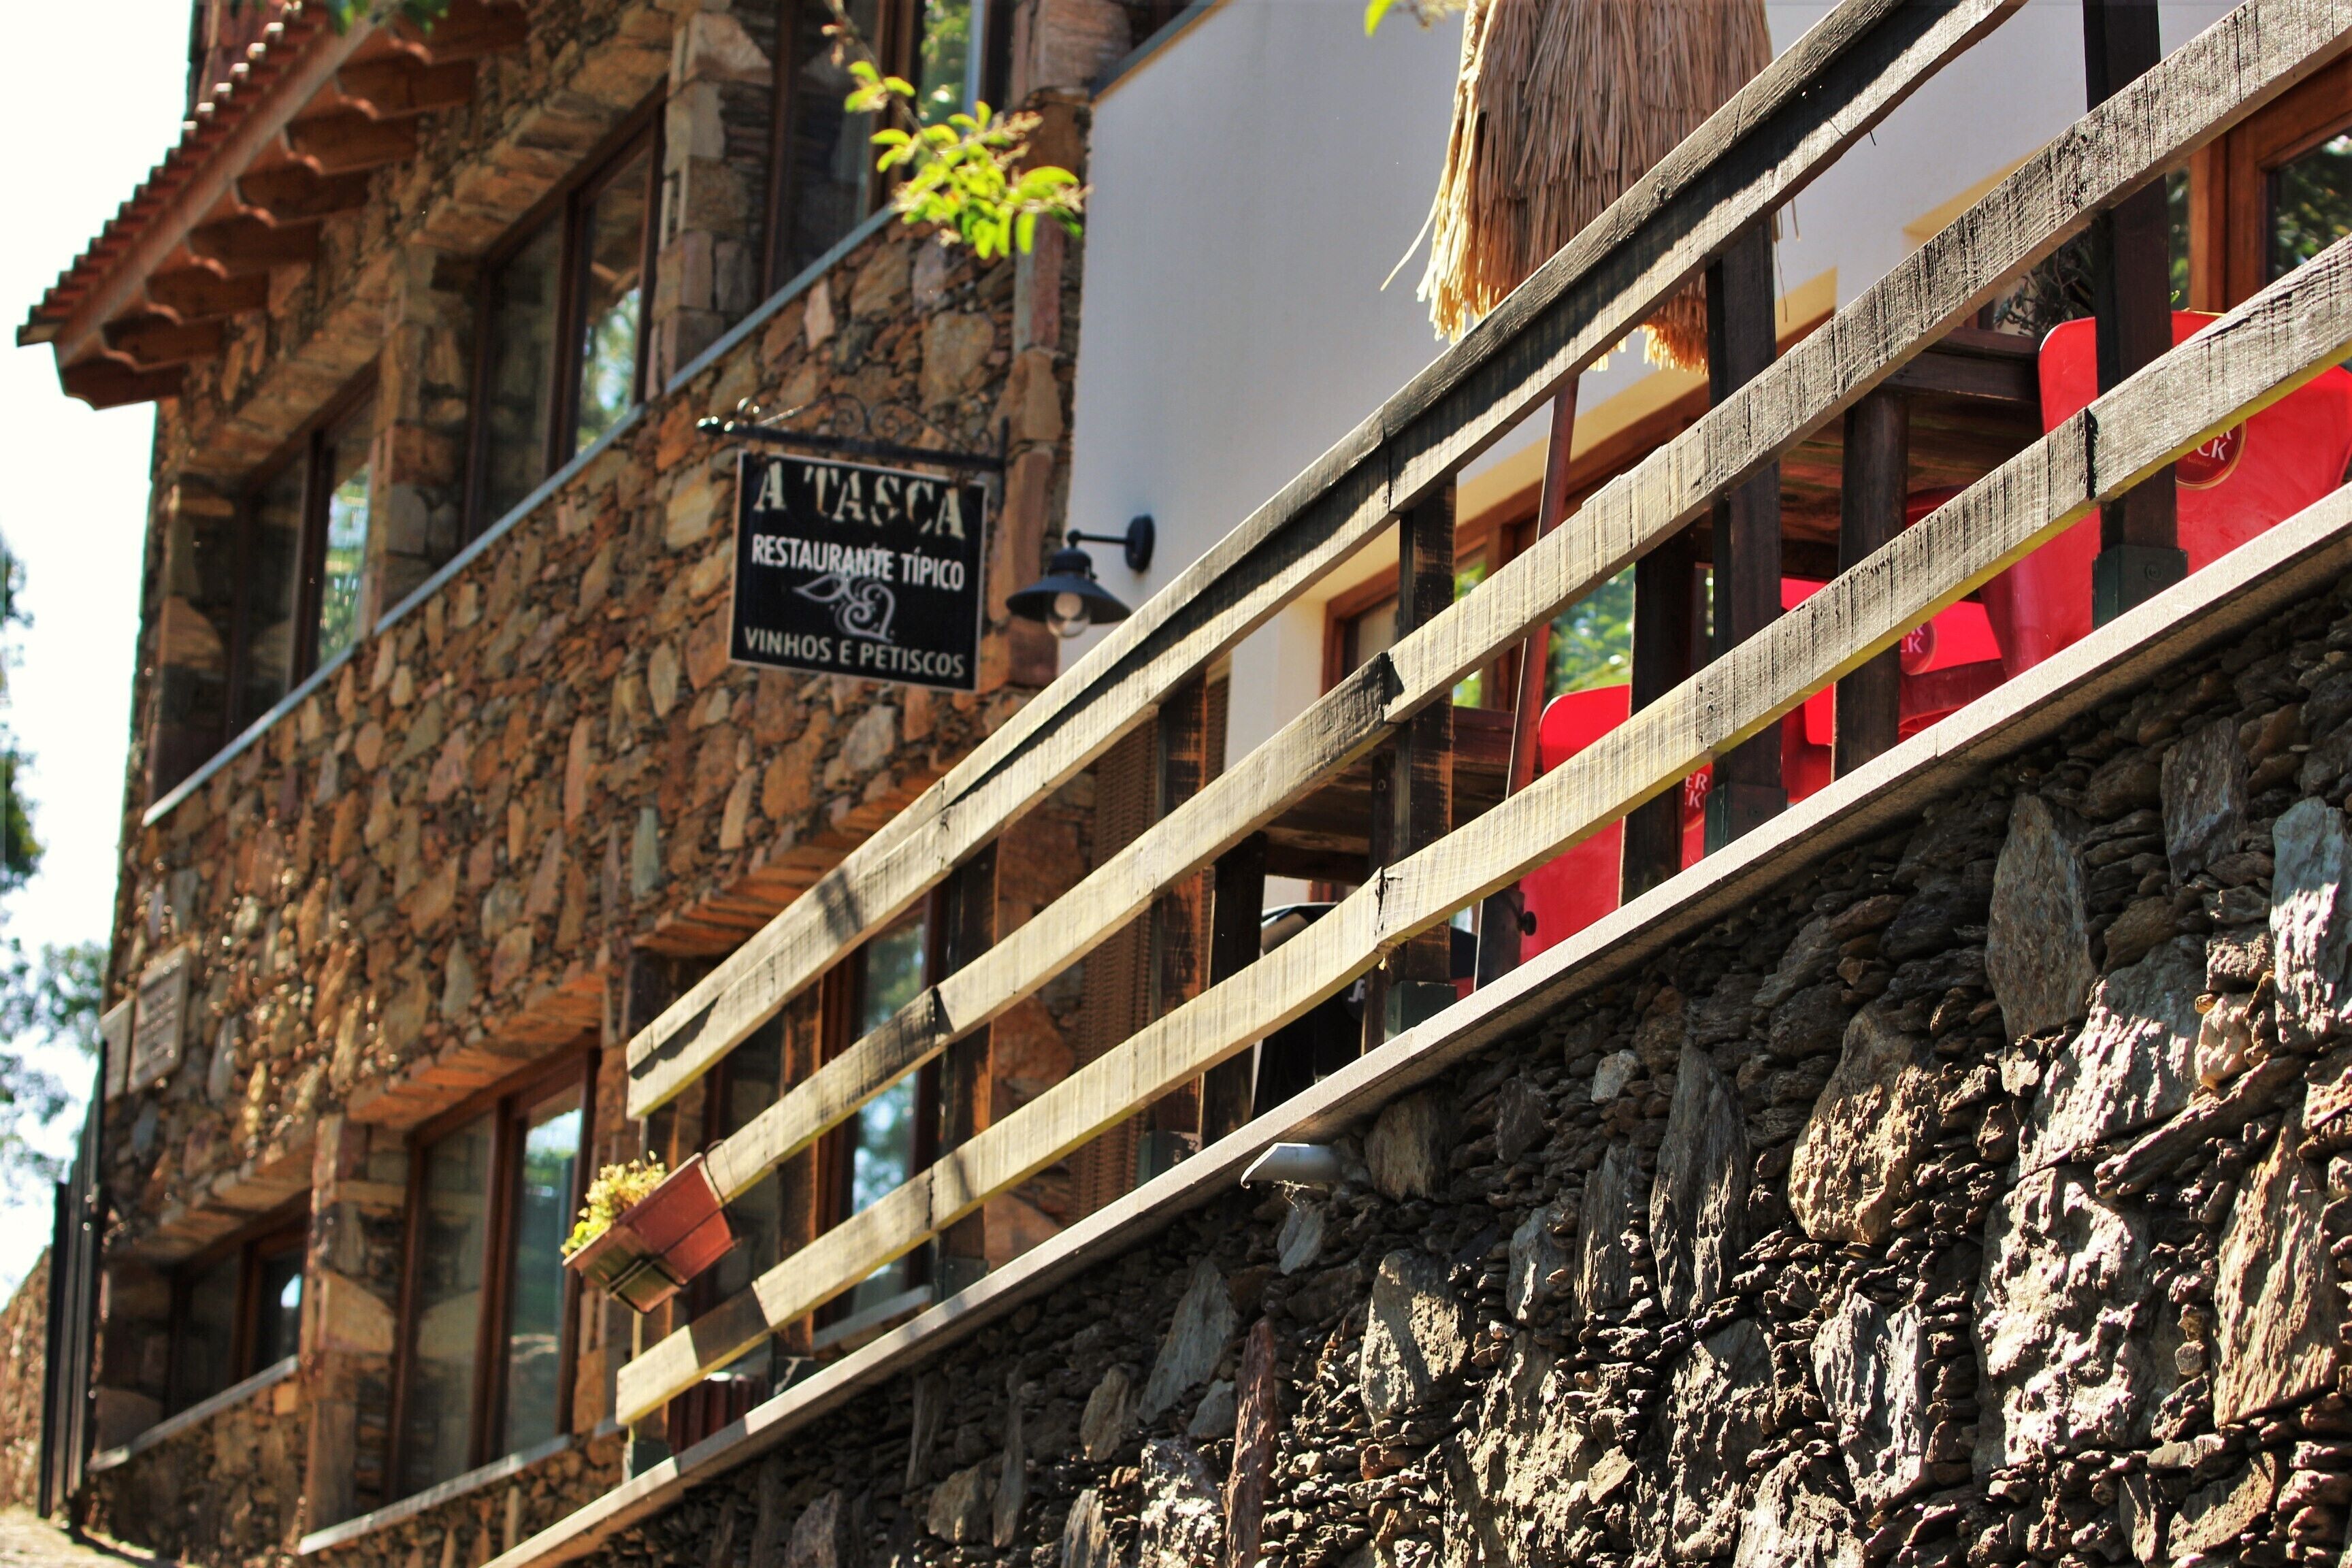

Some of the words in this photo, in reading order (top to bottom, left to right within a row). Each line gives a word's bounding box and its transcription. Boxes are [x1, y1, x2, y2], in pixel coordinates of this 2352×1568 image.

[753, 461, 787, 511] A
[803, 465, 966, 540] TASCA
[751, 534, 894, 582] RESTAURANTE
[900, 546, 965, 591] TÍPICO
[744, 626, 832, 662] VINHOS
[838, 640, 851, 665] E
[859, 642, 964, 678] PETISCOS
